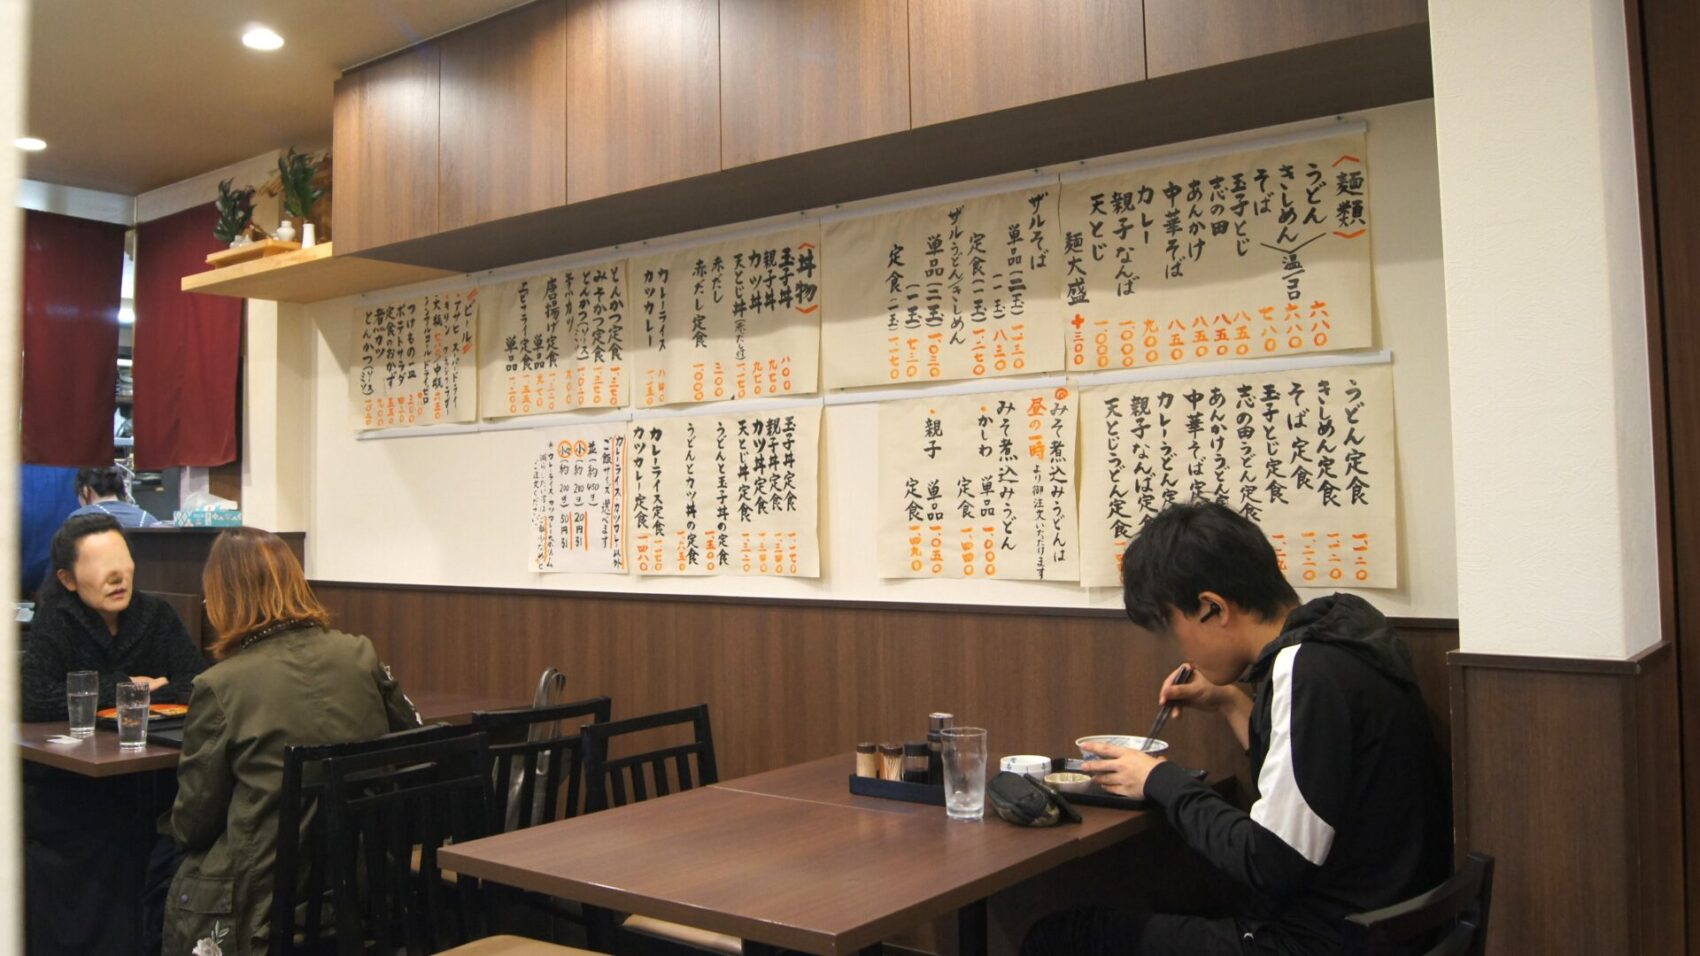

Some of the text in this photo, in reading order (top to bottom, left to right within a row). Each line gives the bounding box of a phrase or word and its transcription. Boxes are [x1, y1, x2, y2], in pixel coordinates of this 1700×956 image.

[1028, 192, 1048, 270] ザルそば
[1089, 193, 1108, 261] 天とじ
[1253, 169, 1272, 215] そば
[1277, 164, 1299, 243] きしめん
[749, 250, 763, 314] カツ丼
[763, 250, 777, 311] 親子丼
[1110, 191, 1140, 297] 親子なんば
[1137, 185, 1159, 362] カレー 九〇〇
[1162, 181, 1186, 361] 中華そば 八五〇
[1186, 179, 1209, 357] あんかけ 八五〇
[1209, 175, 1232, 356] 志の田 八五〇
[1230, 172, 1251, 355] 玉子とじ 八五〇
[1302, 163, 1329, 347] うどん 六八〇
[407, 304, 416, 379] つけもの一皿
[519, 281, 533, 371] エビフライ定食
[543, 277, 559, 368] 唐揚げ定食
[592, 270, 607, 363] みそかつ定食
[608, 266, 624, 361] とんかつ定食
[643, 270, 655, 347] カツカレー
[658, 268, 669, 352] カレーライス
[692, 259, 707, 348] 赤だし定食
[711, 256, 724, 397] 赤だし 三〇〇
[778, 247, 795, 391] 玉子丼 八〇〇
[993, 329, 1008, 371] 八三〇
[1284, 303, 1303, 349] 六八〇
[504, 335, 518, 372] 単品
[533, 333, 545, 370] 単品
[633, 426, 649, 529] カツカレー定食
[650, 427, 665, 537] カレーライス定食
[738, 419, 753, 522] 天とじ丼定食
[752, 419, 768, 515] カツ丼定食
[766, 417, 783, 511] 親子丼定食
[782, 416, 797, 511] 玉子丼定食
[923, 418, 943, 460] 親子
[978, 415, 994, 457] かしわ
[997, 400, 1018, 550] みそ煮込みうどん
[1049, 402, 1068, 562] みそ煮込みうどんは
[1104, 397, 1134, 539] 天とじうどん定食
[1261, 384, 1289, 505] 玉子とじ定食
[1287, 382, 1314, 490] そば定食
[1316, 379, 1341, 507] きしめん定食
[1343, 379, 1370, 506] うどん定食
[685, 422, 699, 565] うどんとカツ丼の定食
[715, 421, 729, 566] うどんと玉子丼の定食
[904, 477, 924, 522] 定食
[926, 478, 944, 521] 単品
[957, 476, 975, 519] 定食
[980, 475, 995, 516] 単品
